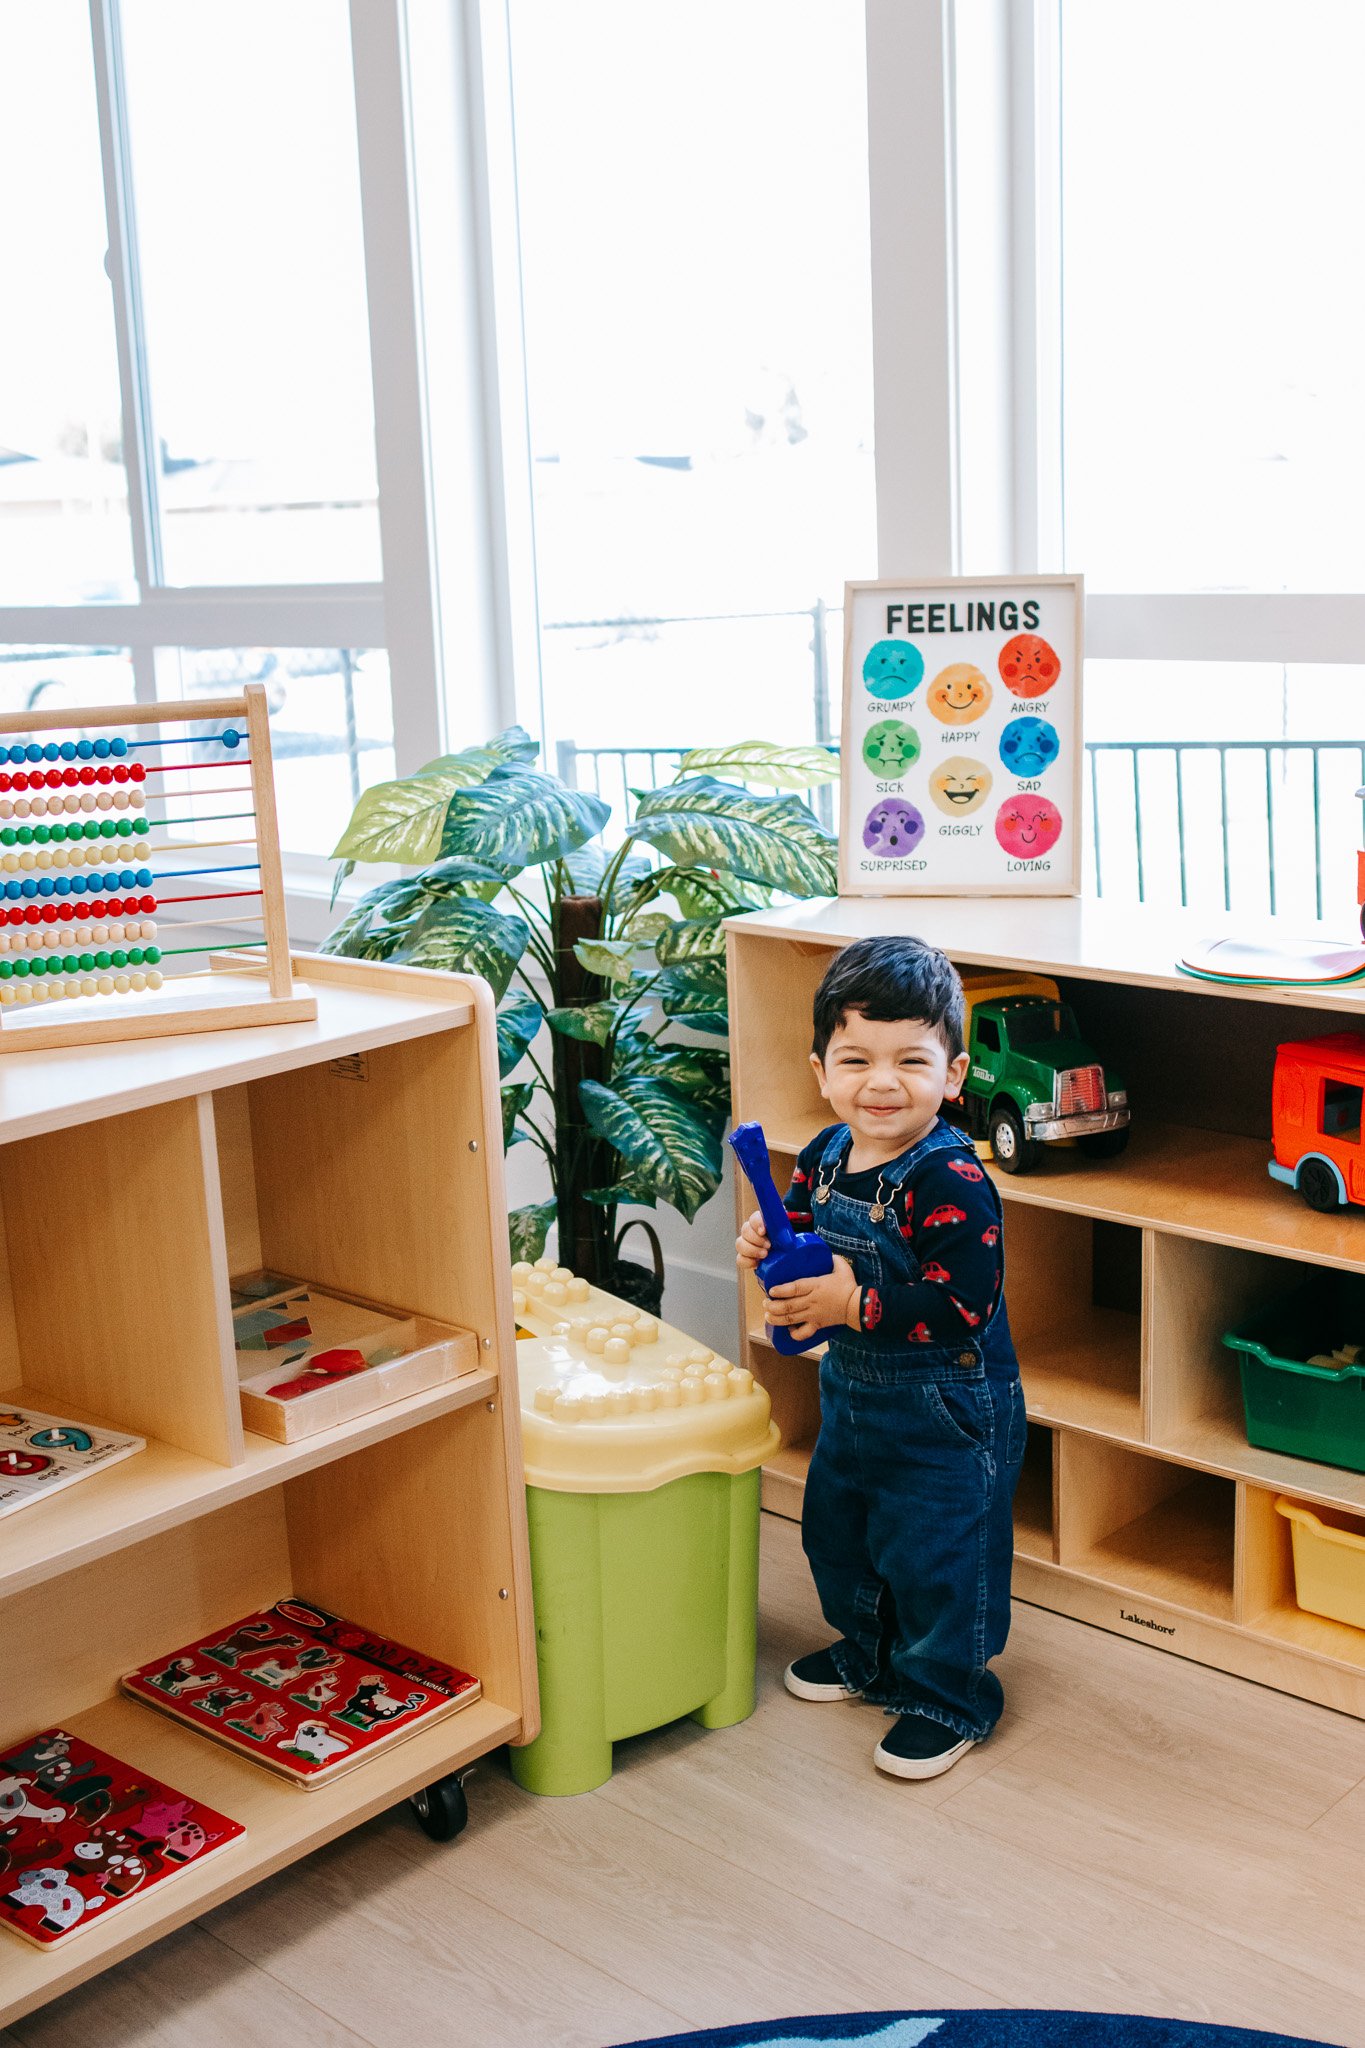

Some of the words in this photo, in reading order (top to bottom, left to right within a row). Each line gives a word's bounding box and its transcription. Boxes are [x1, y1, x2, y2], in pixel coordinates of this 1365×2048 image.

[886, 601, 1040, 633] FEELINGS
[867, 702, 915, 713] GRUMPY
[1011, 702, 1049, 713] ANGRY
[941, 732, 980, 743] HAPPY
[876, 783, 904, 793] SICK
[1017, 781, 1041, 791] SAD
[939, 826, 983, 836] GIGGLY
[860, 861, 927, 872] SURPRISED
[1007, 861, 1050, 872] LOVING
[8, 1425, 33, 1437] four
[90, 1443, 116, 1456] nine
[1119, 1609, 1176, 1635] Lakeshore
